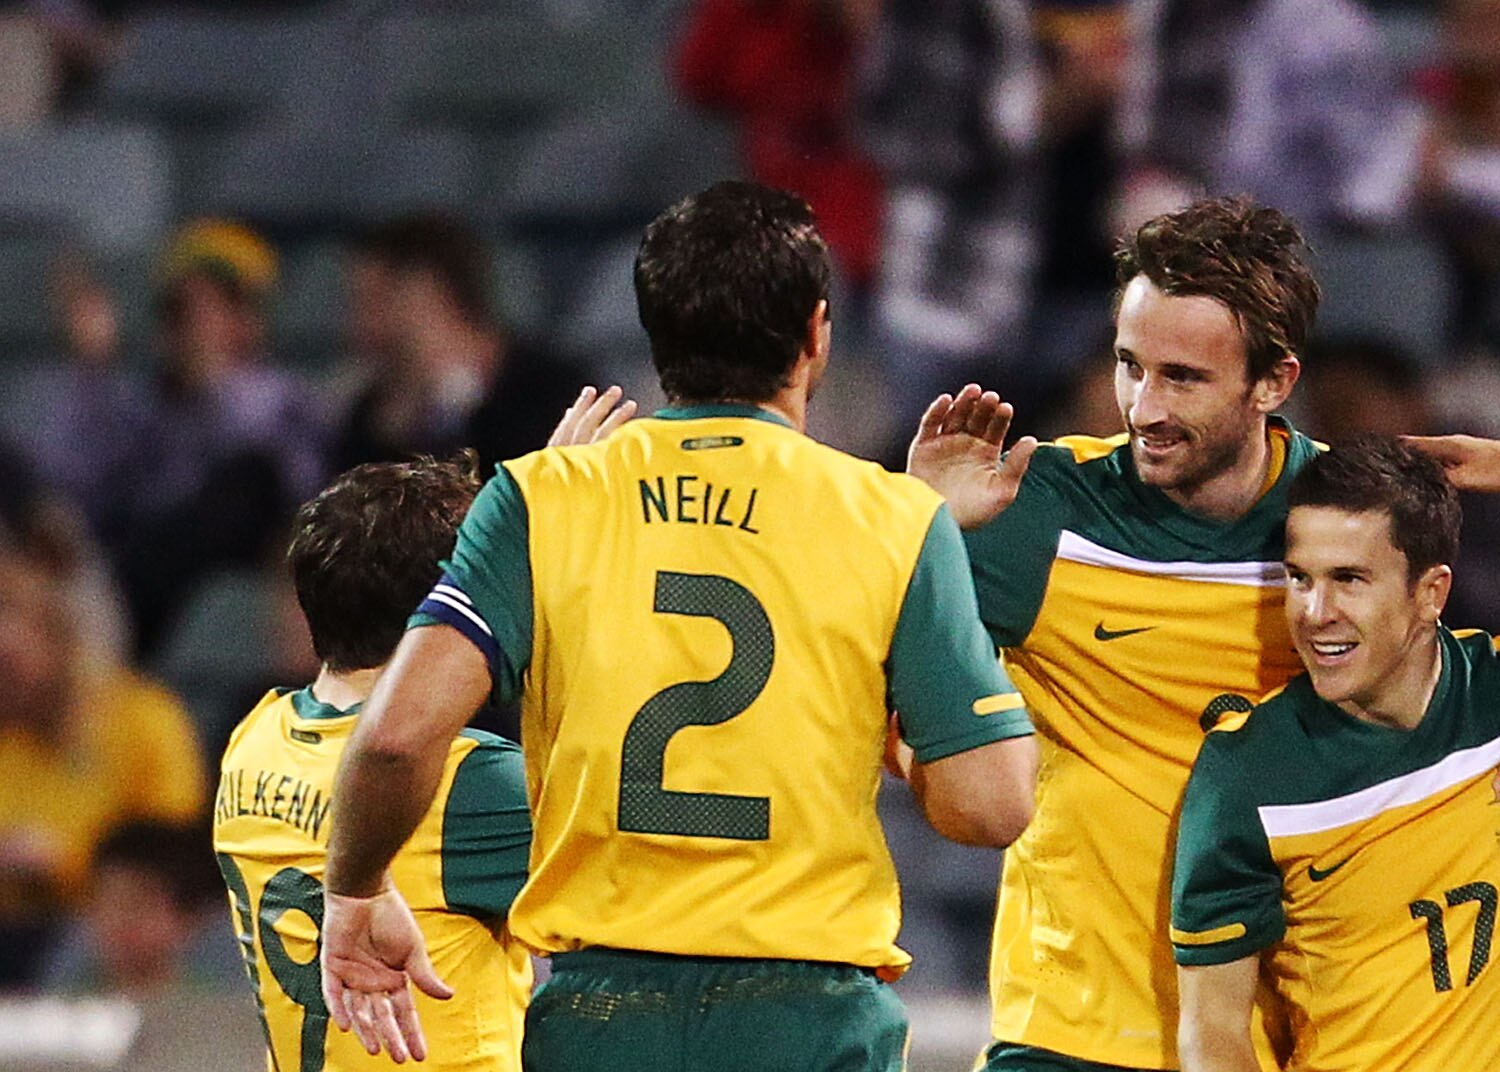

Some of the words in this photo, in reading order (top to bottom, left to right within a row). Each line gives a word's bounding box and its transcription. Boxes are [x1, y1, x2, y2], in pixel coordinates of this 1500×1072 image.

[639, 475, 759, 534] NEILL
[617, 570, 775, 840] 2
[217, 768, 333, 848] KILKENN
[1408, 881, 1498, 993] 17
